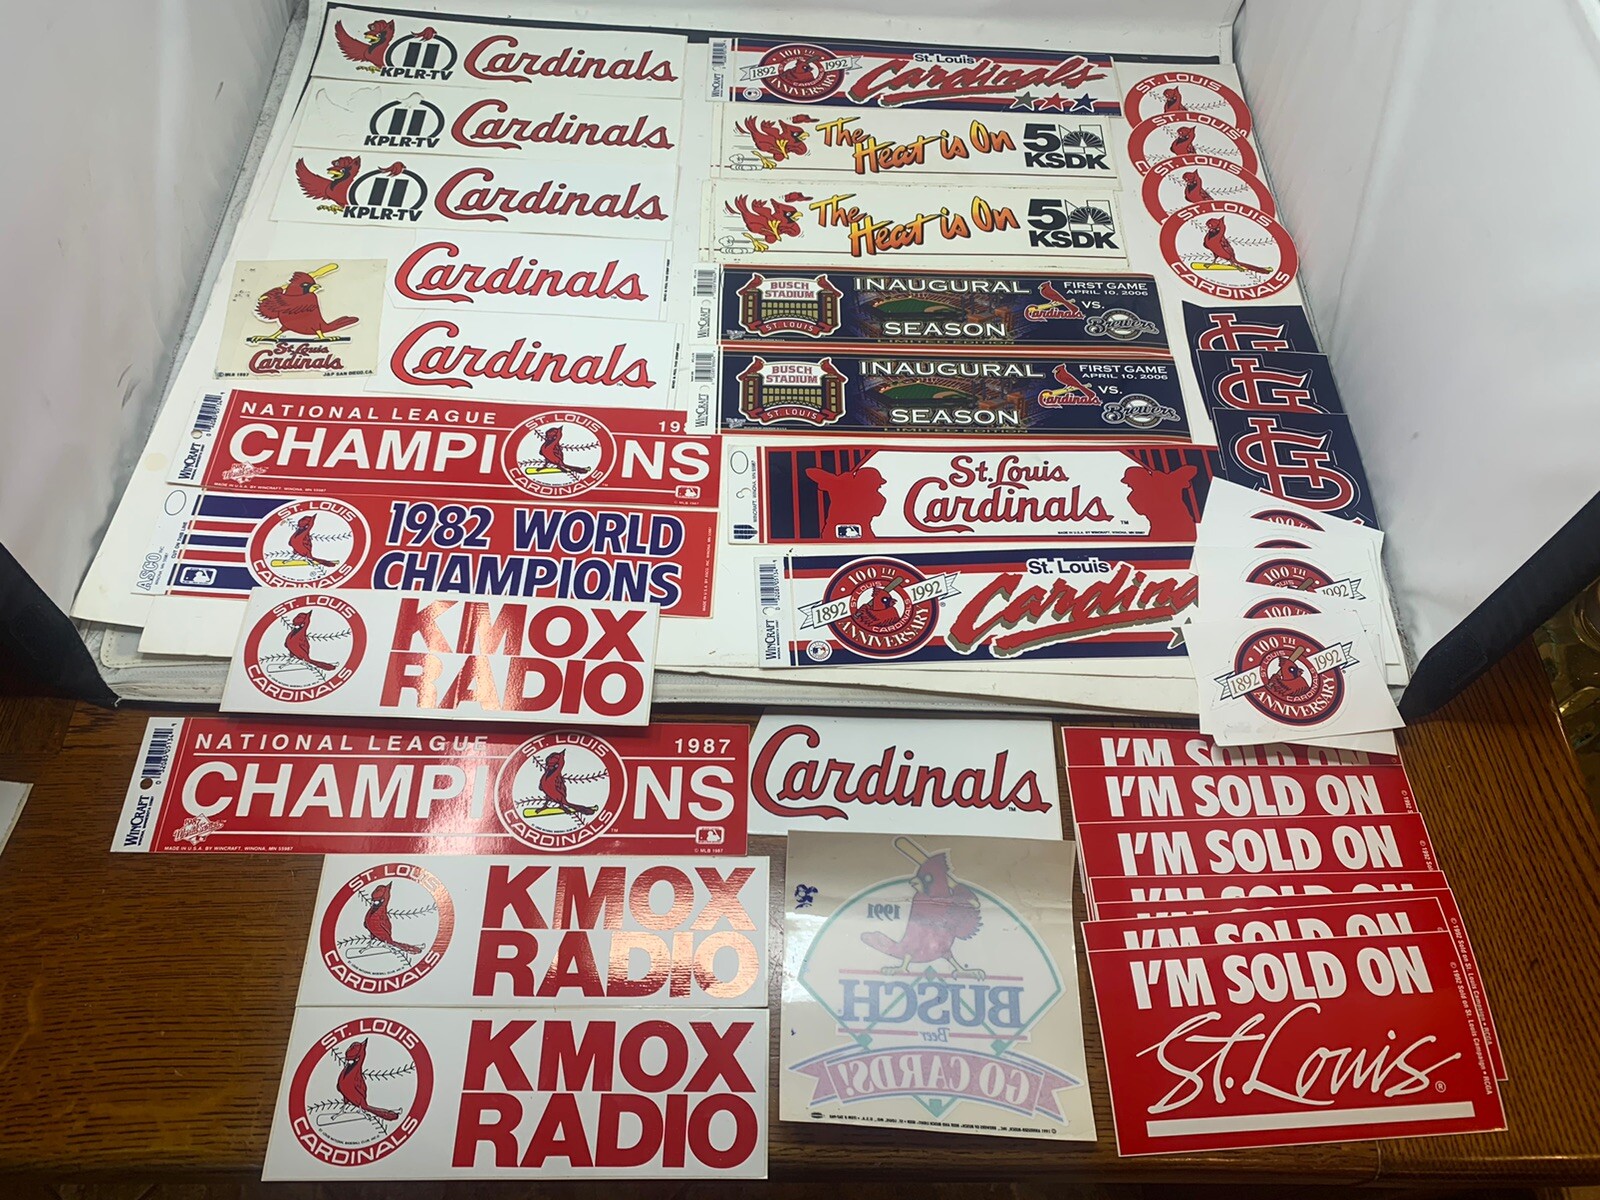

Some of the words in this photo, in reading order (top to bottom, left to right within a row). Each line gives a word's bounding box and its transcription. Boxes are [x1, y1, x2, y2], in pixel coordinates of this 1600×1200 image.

[464, 35, 678, 83] Cardinals
[825, 59, 848, 71] 1992
[914, 53, 938, 63] St.
[940, 53, 976, 64] Louis
[380, 66, 453, 81] KPLR-TV
[752, 66, 776, 78] 1892
[846, 54, 1107, 107] Cardinals
[1135, 75, 1161, 93] ST.
[1166, 73, 1222, 92] LOUIS
[451, 99, 674, 150] Cardinals
[1152, 113, 1179, 127] ST.
[1186, 113, 1241, 140] LOUIS
[364, 135, 440, 149] KPLR-TV
[816, 117, 870, 147] The
[853, 136, 940, 174] Heat
[939, 130, 969, 159] is
[969, 120, 1015, 152] On
[1023, 123, 1061, 152] 5
[1024, 152, 1110, 170] KSDK
[1154, 159, 1179, 176] ST.
[1184, 157, 1242, 175] LOUIS
[434, 167, 668, 222] Cardinals
[343, 205, 422, 222] KPLR-TV
[810, 193, 866, 228] The
[848, 213, 940, 257] Heat
[939, 206, 971, 240] is
[970, 196, 1020, 230] On
[1027, 199, 1066, 230] 5
[1177, 203, 1206, 221] ST.
[1211, 202, 1273, 228] LOUIS
[1029, 230, 1120, 249] KSDK
[394, 241, 649, 303] Cardinals
[1171, 261, 1291, 300] CARDINALS
[765, 290, 814, 298] STADIUM
[770, 281, 809, 290] BUSCH
[854, 278, 1032, 294] INAUGURAL
[1063, 282, 1103, 290] FIRST
[1107, 282, 1147, 291] GAME
[1024, 304, 1086, 322] Cardinals
[1081, 301, 1104, 309] VS.
[783, 321, 814, 332] LOUIS
[883, 321, 1008, 338] SEASON
[1084, 316, 1159, 336] Brewers
[249, 349, 344, 374] Cardinals
[390, 320, 656, 389] Cardinals
[766, 375, 818, 383] STADIUM
[771, 366, 812, 374] BUSCH
[859, 361, 1046, 378] INAUGURAL
[1079, 365, 1120, 373] FIRST
[1124, 365, 1168, 374] GAME
[1038, 389, 1103, 409] Cardinals
[1098, 386, 1123, 394] VS.
[241, 401, 380, 420] NATIONAL
[391, 406, 496, 425] LEAGUE
[525, 416, 550, 430] ST.
[554, 414, 602, 433] LOUIS
[785, 410, 818, 420] LOUIS
[890, 408, 1020, 425] SEASON
[1102, 403, 1181, 424] Brewers
[508, 468, 604, 496] CARDINALS
[949, 455, 992, 487] St.
[988, 455, 1070, 489] Louis
[277, 503, 303, 519] ST.
[309, 500, 357, 523] LOUIS
[903, 476, 1114, 534] Cardinals
[386, 499, 494, 550] 1982
[514, 507, 685, 560] WORLD
[136, 552, 162, 591] ASCO
[371, 550, 682, 609] CHAMPIONS
[848, 567, 877, 585] 100
[1028, 559, 1054, 575] St.
[1058, 560, 1111, 576] Louis
[1264, 566, 1289, 583] 100
[911, 581, 942, 602] 1992
[272, 598, 299, 617] ST.
[306, 595, 355, 620] LOUIS
[815, 602, 848, 624] 1892
[872, 598, 912, 633] CARDINALS
[391, 597, 647, 663] KMOX
[839, 605, 929, 648] ANNIVERSARY
[765, 619, 775, 661] WINCRAFT
[1253, 637, 1279, 656] 100
[1281, 637, 1296, 646] TH
[1314, 649, 1342, 671] 1992
[247, 664, 353, 701] CARDINALS
[379, 651, 644, 717] RADIO
[1230, 672, 1260, 694] 1892
[1254, 673, 1335, 717] ANNIVERSARY
[1286, 667, 1318, 702] CARDINALS
[195, 733, 353, 751] NATIONAL
[368, 735, 488, 752] LEAGUE
[522, 736, 550, 757] ST.
[556, 734, 610, 758] LOUIS
[675, 738, 731, 755] 1987
[750, 724, 1052, 820] Cardinals
[1105, 776, 1184, 817] I'M
[1191, 774, 1306, 817] SOLD
[1315, 774, 1385, 815] ON
[124, 795, 149, 847] WINCRAFT
[504, 808, 613, 847] CARDINALS
[1117, 831, 1199, 876] I'M
[1205, 828, 1322, 874] SOLD
[1332, 825, 1404, 869] ON
[348, 867, 381, 890] ST.
[384, 863, 443, 898] LOUIS
[482, 865, 756, 930] KMOX
[322, 949, 442, 993] CARDINALS
[472, 930, 760, 998] RADIO
[1129, 958, 1216, 1010] I'M
[1222, 950, 1347, 1004] SOLD
[1356, 945, 1433, 996] ON
[320, 1023, 354, 1050] ST.
[362, 1019, 420, 1051] LOUIS
[462, 1020, 757, 1093] KMOX
[1136, 1012, 1266, 1115] St.
[1241, 1002, 1462, 1106] Louis
[1473, 1038, 1486, 1070] Campaign
[294, 1116, 420, 1168] CARDINALS
[451, 1092, 759, 1169] RADIO
